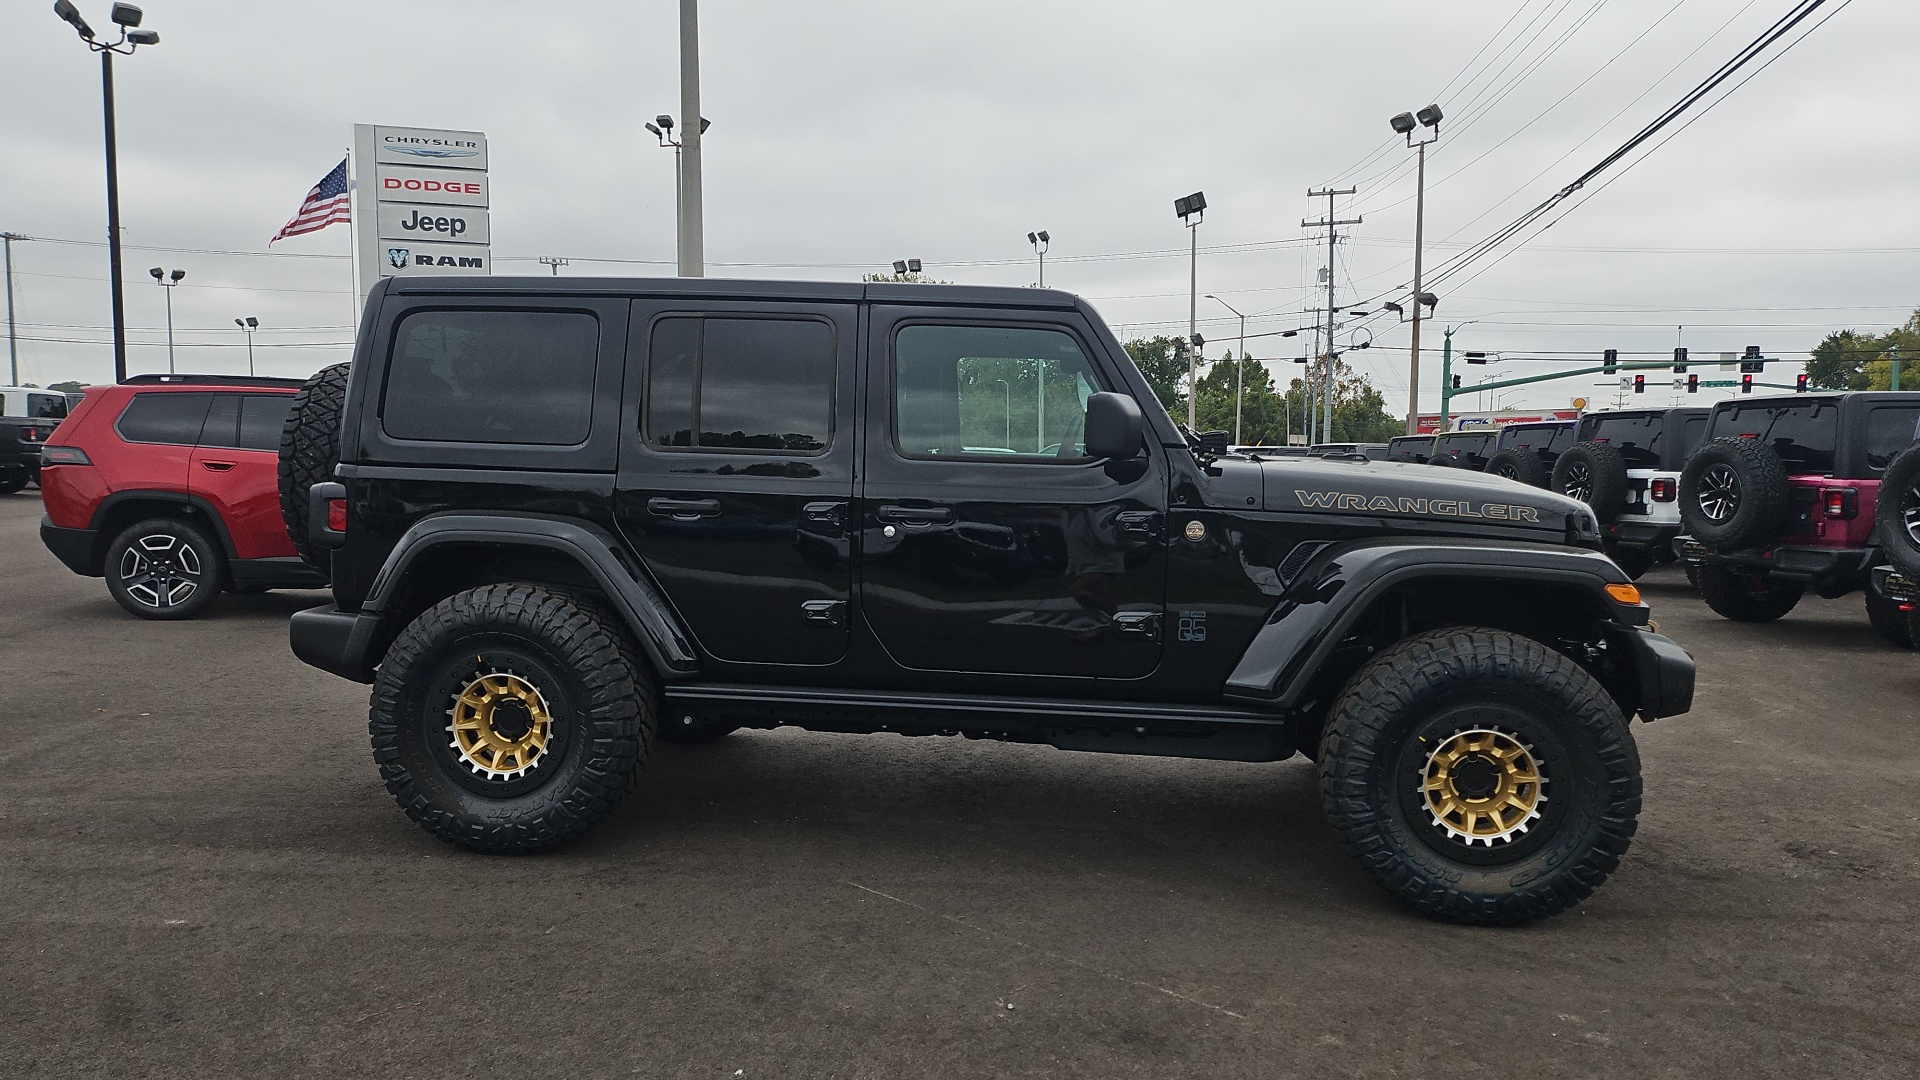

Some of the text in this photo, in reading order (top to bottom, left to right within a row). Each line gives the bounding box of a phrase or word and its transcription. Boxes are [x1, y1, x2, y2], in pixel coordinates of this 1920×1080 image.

[384, 136, 477, 149] CHRYSLER
[384, 178, 481, 195] DODGE
[401, 210, 466, 238] Jeep
[415, 254, 483, 269] RAM
[1294, 489, 1540, 523] WRANGLER
